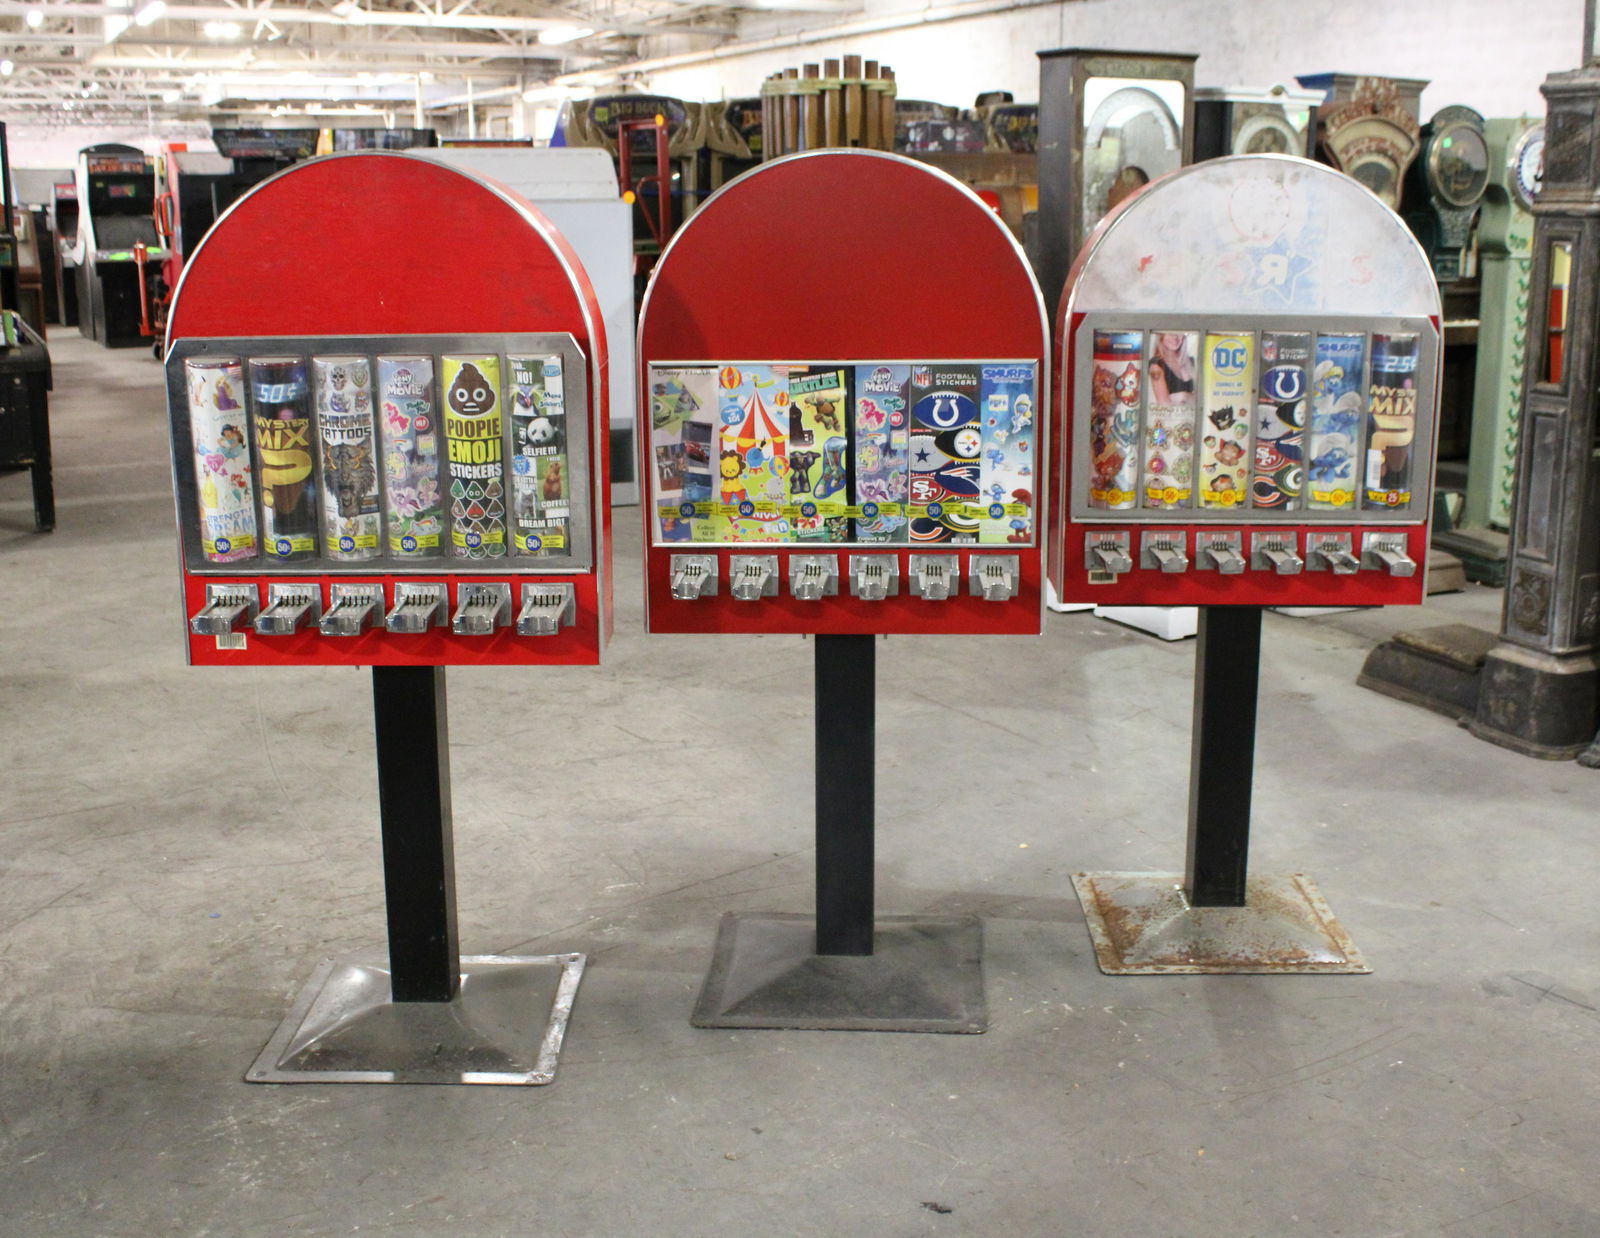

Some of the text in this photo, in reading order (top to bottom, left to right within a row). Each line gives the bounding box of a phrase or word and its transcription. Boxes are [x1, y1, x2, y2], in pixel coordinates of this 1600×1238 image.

[1215, 348, 1246, 368] DC
[516, 371, 533, 385] NO!
[789, 375, 839, 396] URTLES
[864, 381, 901, 392] MOVIE
[915, 373, 933, 386] NFL
[387, 383, 424, 396] MOVIE
[1369, 396, 1416, 415] MIX
[254, 414, 309, 429] MYSTERY
[319, 412, 372, 429] CHROME
[447, 418, 500, 438] POOPIE
[256, 427, 309, 449] MIX
[320, 426, 372, 440] TATTOOS
[448, 439, 502, 464] EMOJI
[449, 462, 503, 479] STICKERS
[518, 519, 546, 528] DREAM
